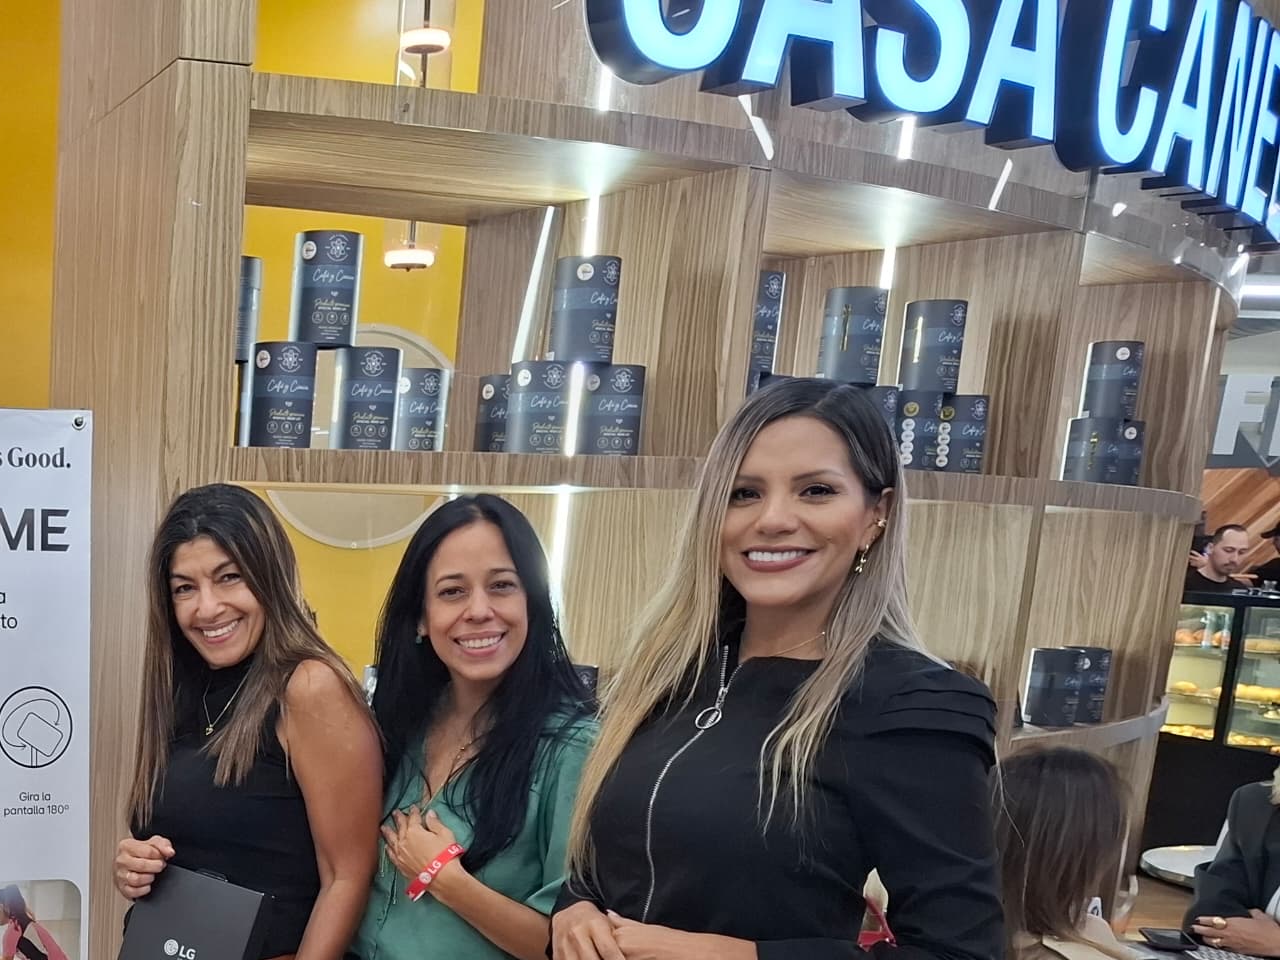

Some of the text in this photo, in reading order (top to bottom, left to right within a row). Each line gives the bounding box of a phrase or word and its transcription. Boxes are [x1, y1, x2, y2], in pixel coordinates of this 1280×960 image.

[1098, 0, 1280, 238] CANE
[7, 446, 71, 469] Good.
[18, 791, 51, 802] Gira la
[3, 805, 45, 817] pantalla
[178, 945, 196, 960] LG
